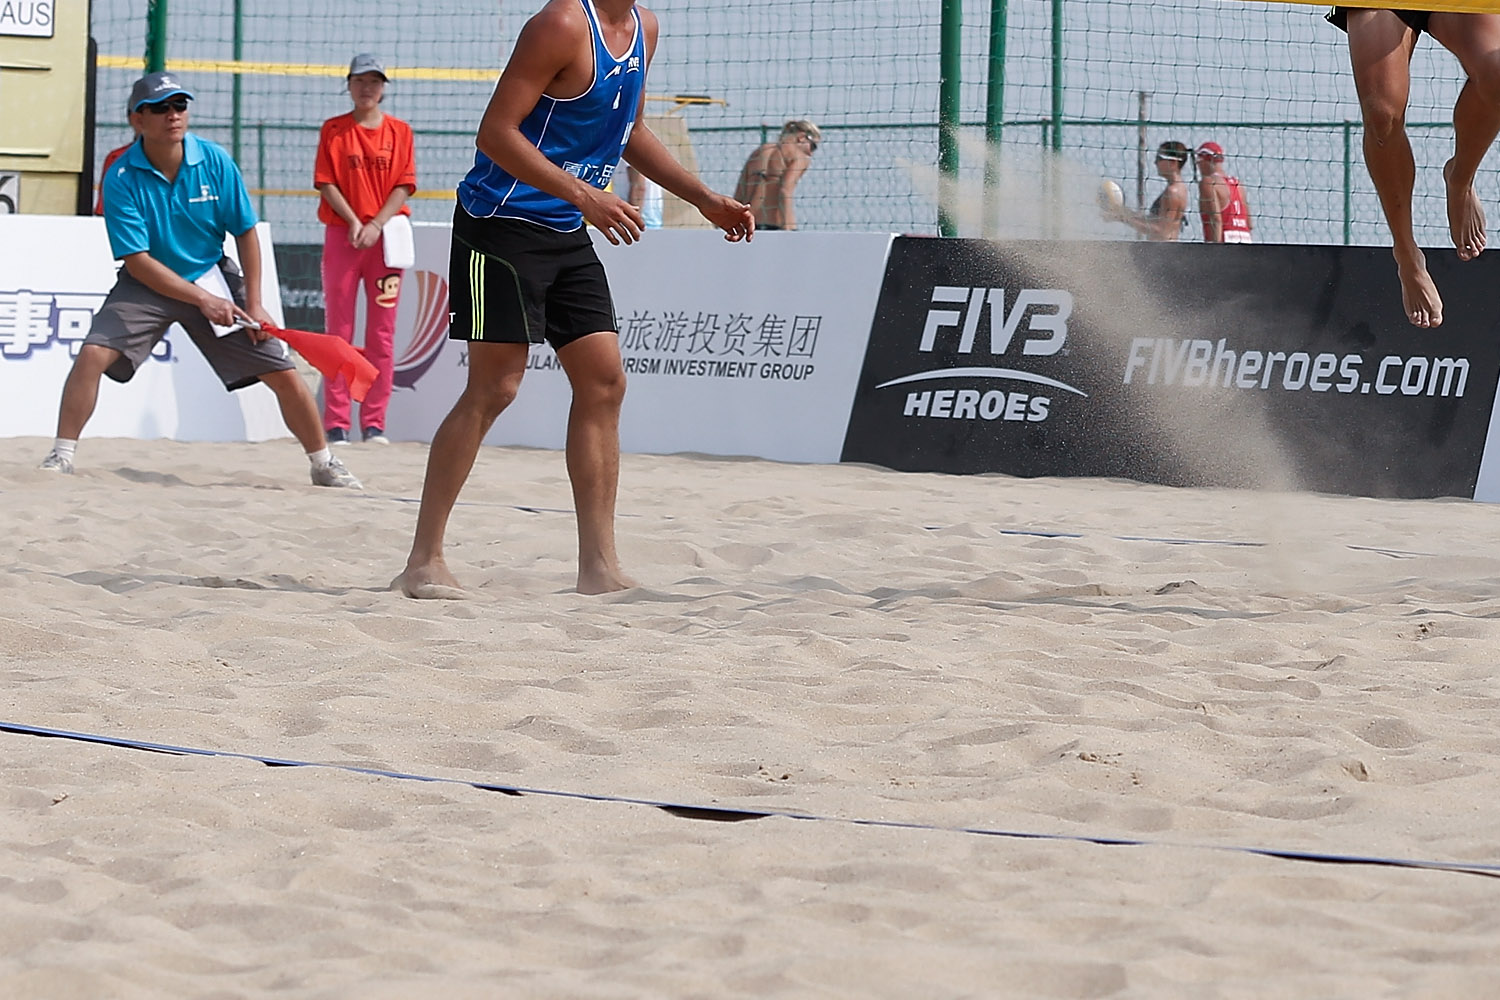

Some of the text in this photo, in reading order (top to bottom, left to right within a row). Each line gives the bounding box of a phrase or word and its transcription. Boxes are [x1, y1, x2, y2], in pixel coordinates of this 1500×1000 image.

[0, 1, 51, 26] AUS
[919, 286, 1074, 356] FIVB
[663, 360, 758, 379] INVESTMENT
[760, 362, 815, 380] GROUP
[1123, 338, 1470, 397] FIVBheroes.com
[903, 389, 1051, 423] HEROES
